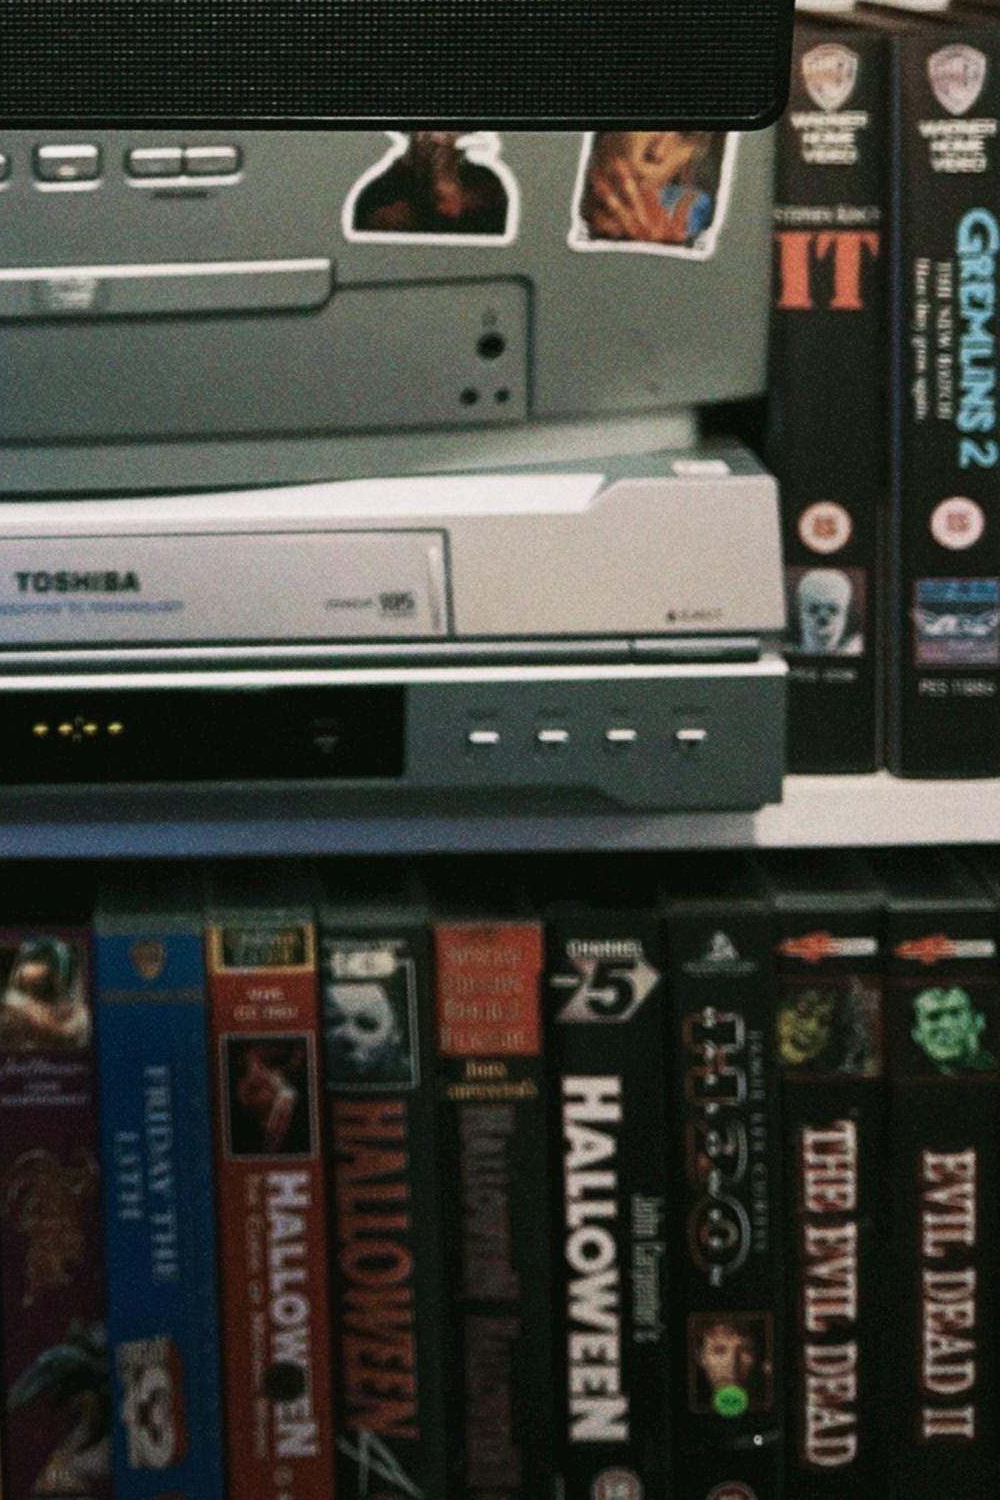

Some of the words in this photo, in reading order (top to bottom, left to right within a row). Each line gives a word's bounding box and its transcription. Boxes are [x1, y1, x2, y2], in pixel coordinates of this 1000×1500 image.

[774, 230, 881, 311] IT
[956, 207, 1000, 433] GREMLINS
[957, 437, 1000, 470] 2
[14, 571, 140, 593] TOSHIBA
[587, 961, 637, 1016] 5
[143, 1063, 177, 1194] FRIDAY
[802, 1119, 859, 1214] THE
[150, 1211, 180, 1285] THE
[920, 1147, 979, 1259] EVIL
[265, 1169, 320, 1459] HALLOWEN
[335, 1100, 420, 1439] HALLOWEEN
[561, 1074, 630, 1445] HALLOWEEN
[802, 1222, 859, 1334] EVIL
[920, 1268, 979, 1397] DEAD
[802, 1340, 859, 1468] DEAD
[920, 1406, 979, 1441] II
